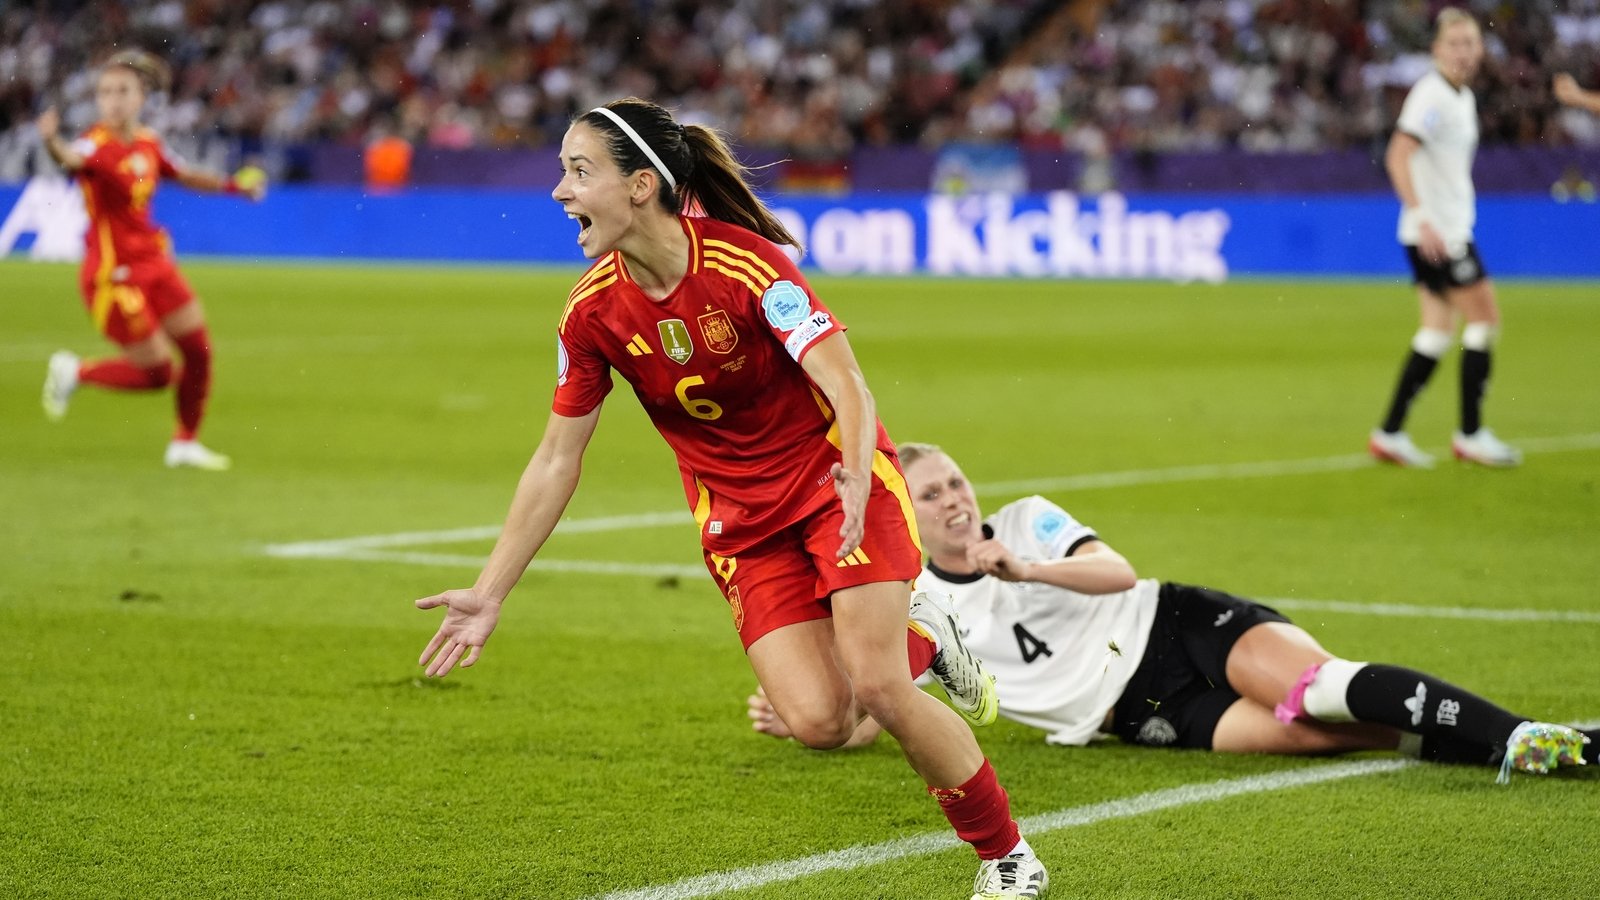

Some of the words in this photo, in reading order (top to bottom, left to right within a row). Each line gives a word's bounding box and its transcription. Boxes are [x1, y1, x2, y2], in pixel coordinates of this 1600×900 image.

[811, 207, 917, 275] on
[924, 190, 1231, 283] Kicking
[675, 375, 723, 420] 6
[1012, 622, 1053, 663] 4
